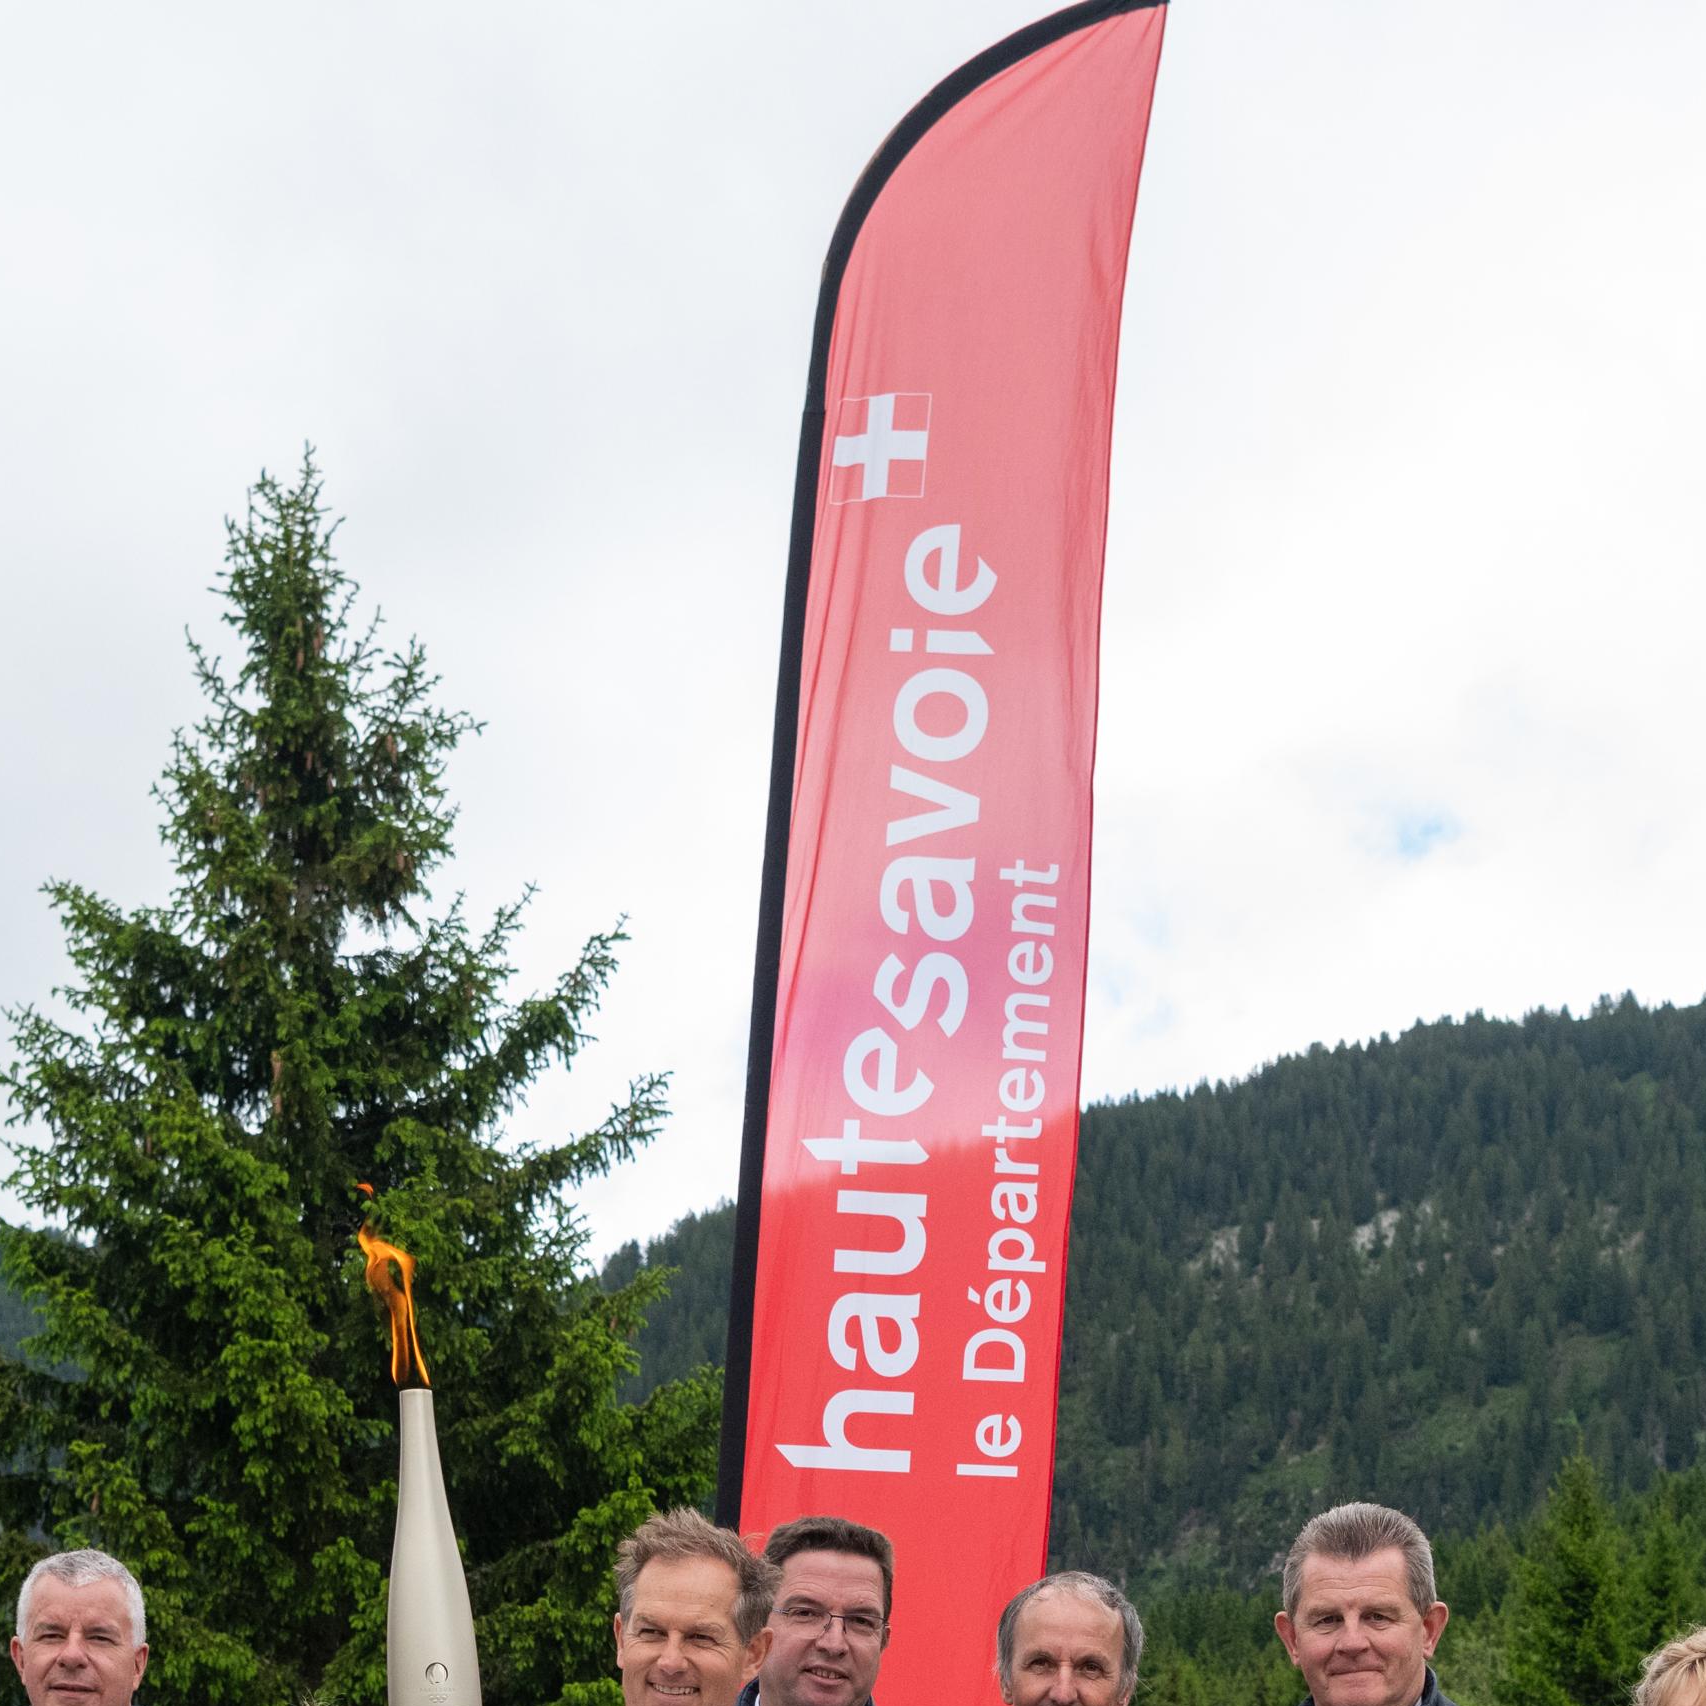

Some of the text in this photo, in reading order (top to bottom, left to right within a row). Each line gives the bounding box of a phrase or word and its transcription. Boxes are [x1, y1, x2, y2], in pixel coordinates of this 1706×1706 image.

[775, 523, 998, 1473] hautesavoie
[956, 858, 1060, 1478] le Département
